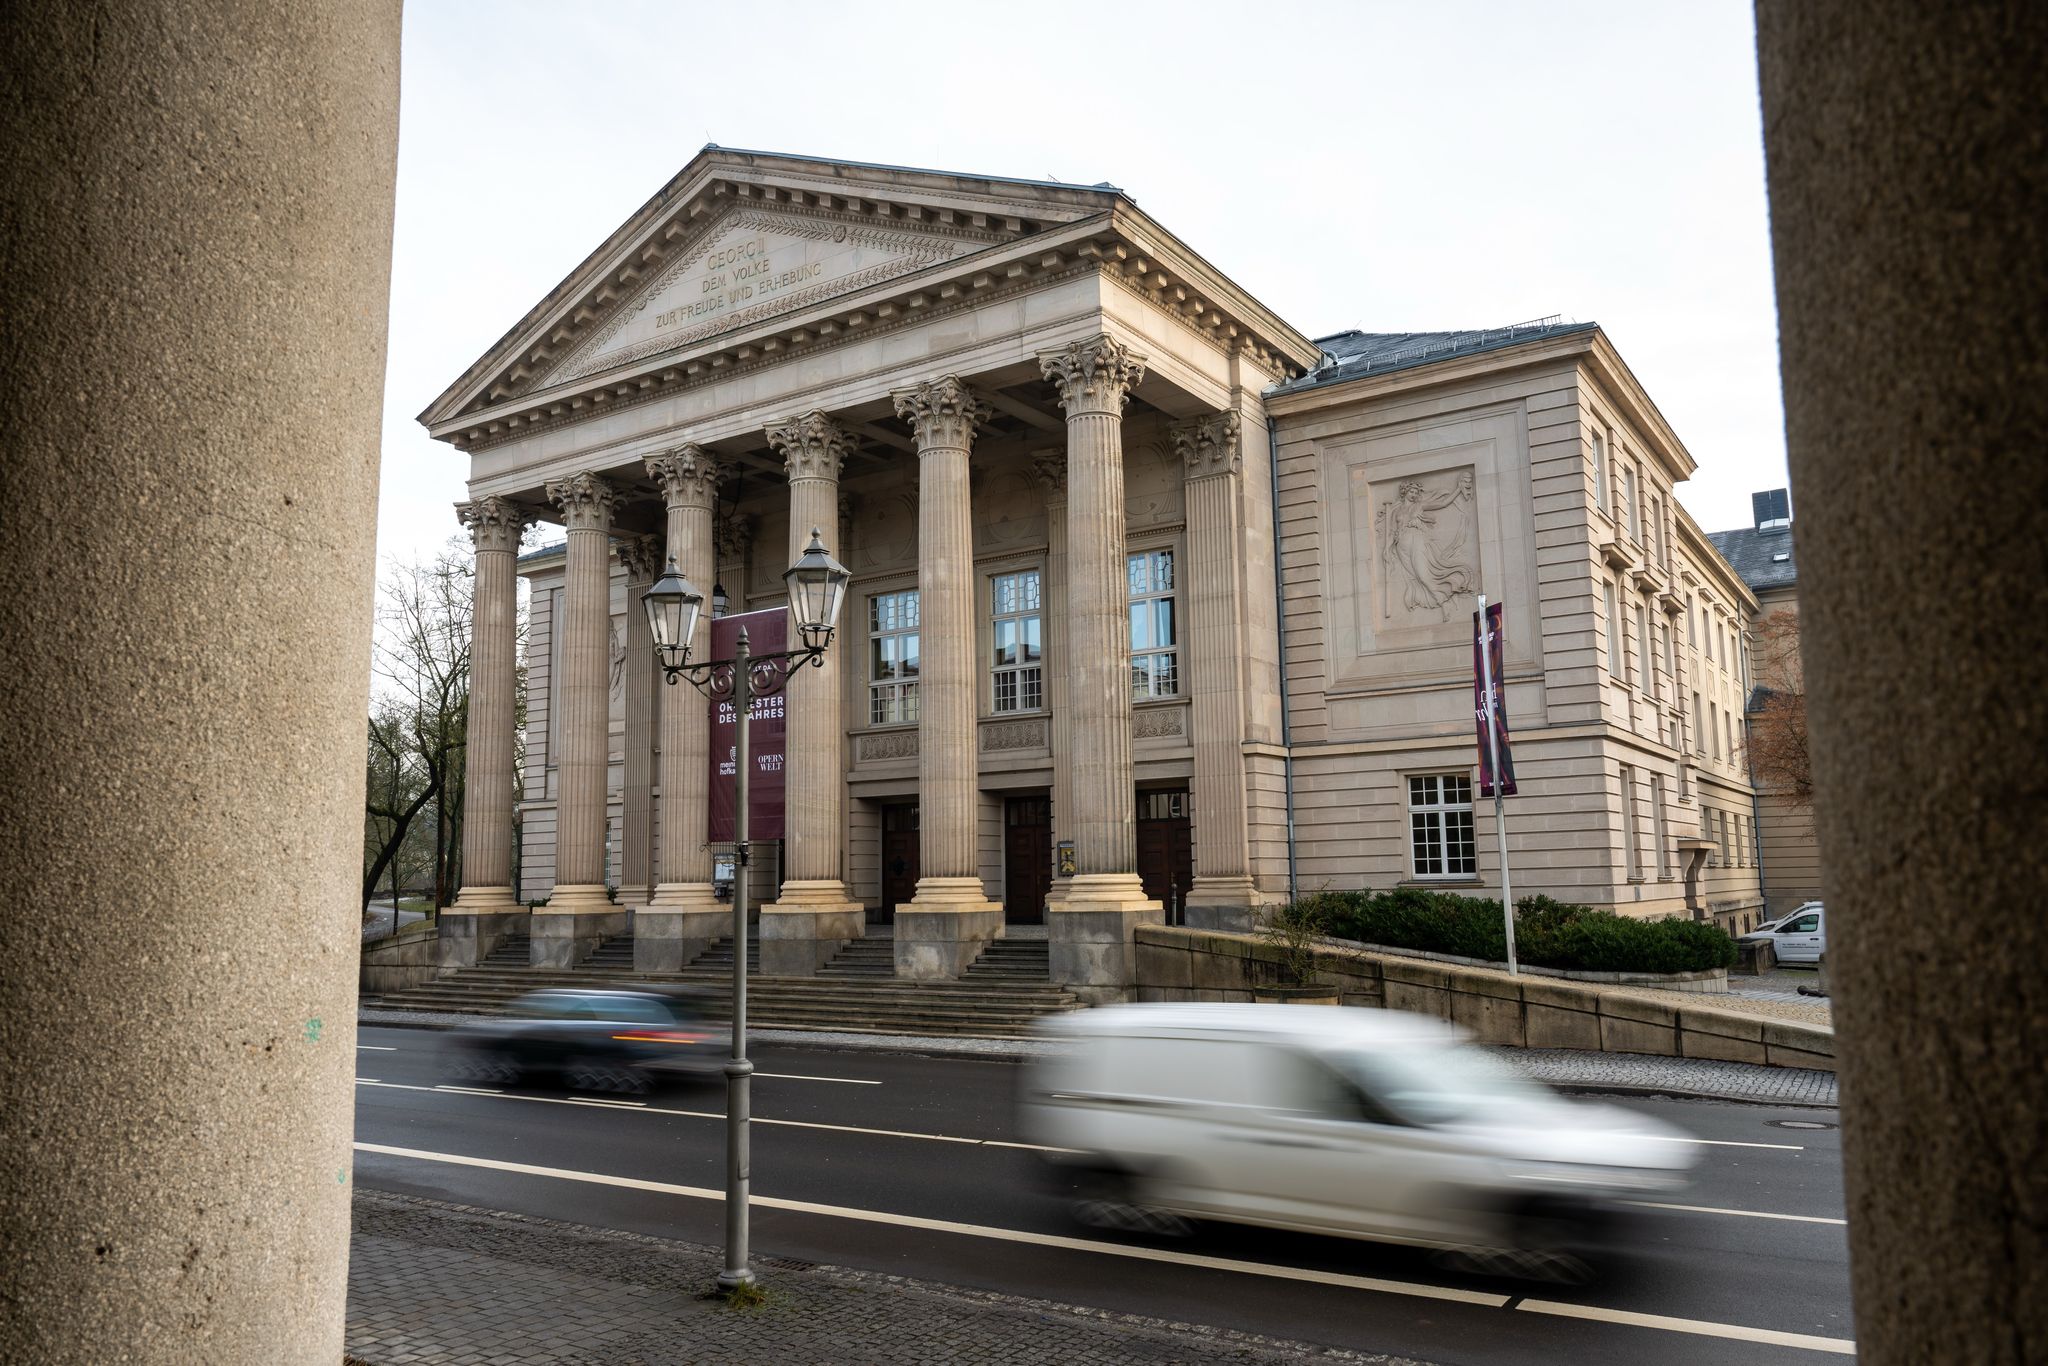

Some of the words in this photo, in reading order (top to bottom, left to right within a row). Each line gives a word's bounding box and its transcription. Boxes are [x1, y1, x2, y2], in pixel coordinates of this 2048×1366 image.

[702, 274, 727, 293] DEM
[732, 259, 770, 281] VOLKE
[656, 311, 677, 328] ZUR
[680, 295, 724, 320] FREUDE
[729, 286, 753, 304] UND
[759, 263, 821, 295] ERHEBUNG
[748, 707, 784, 721] AHRES
[757, 753, 784, 763] OPERN
[760, 762, 782, 771] WELT
